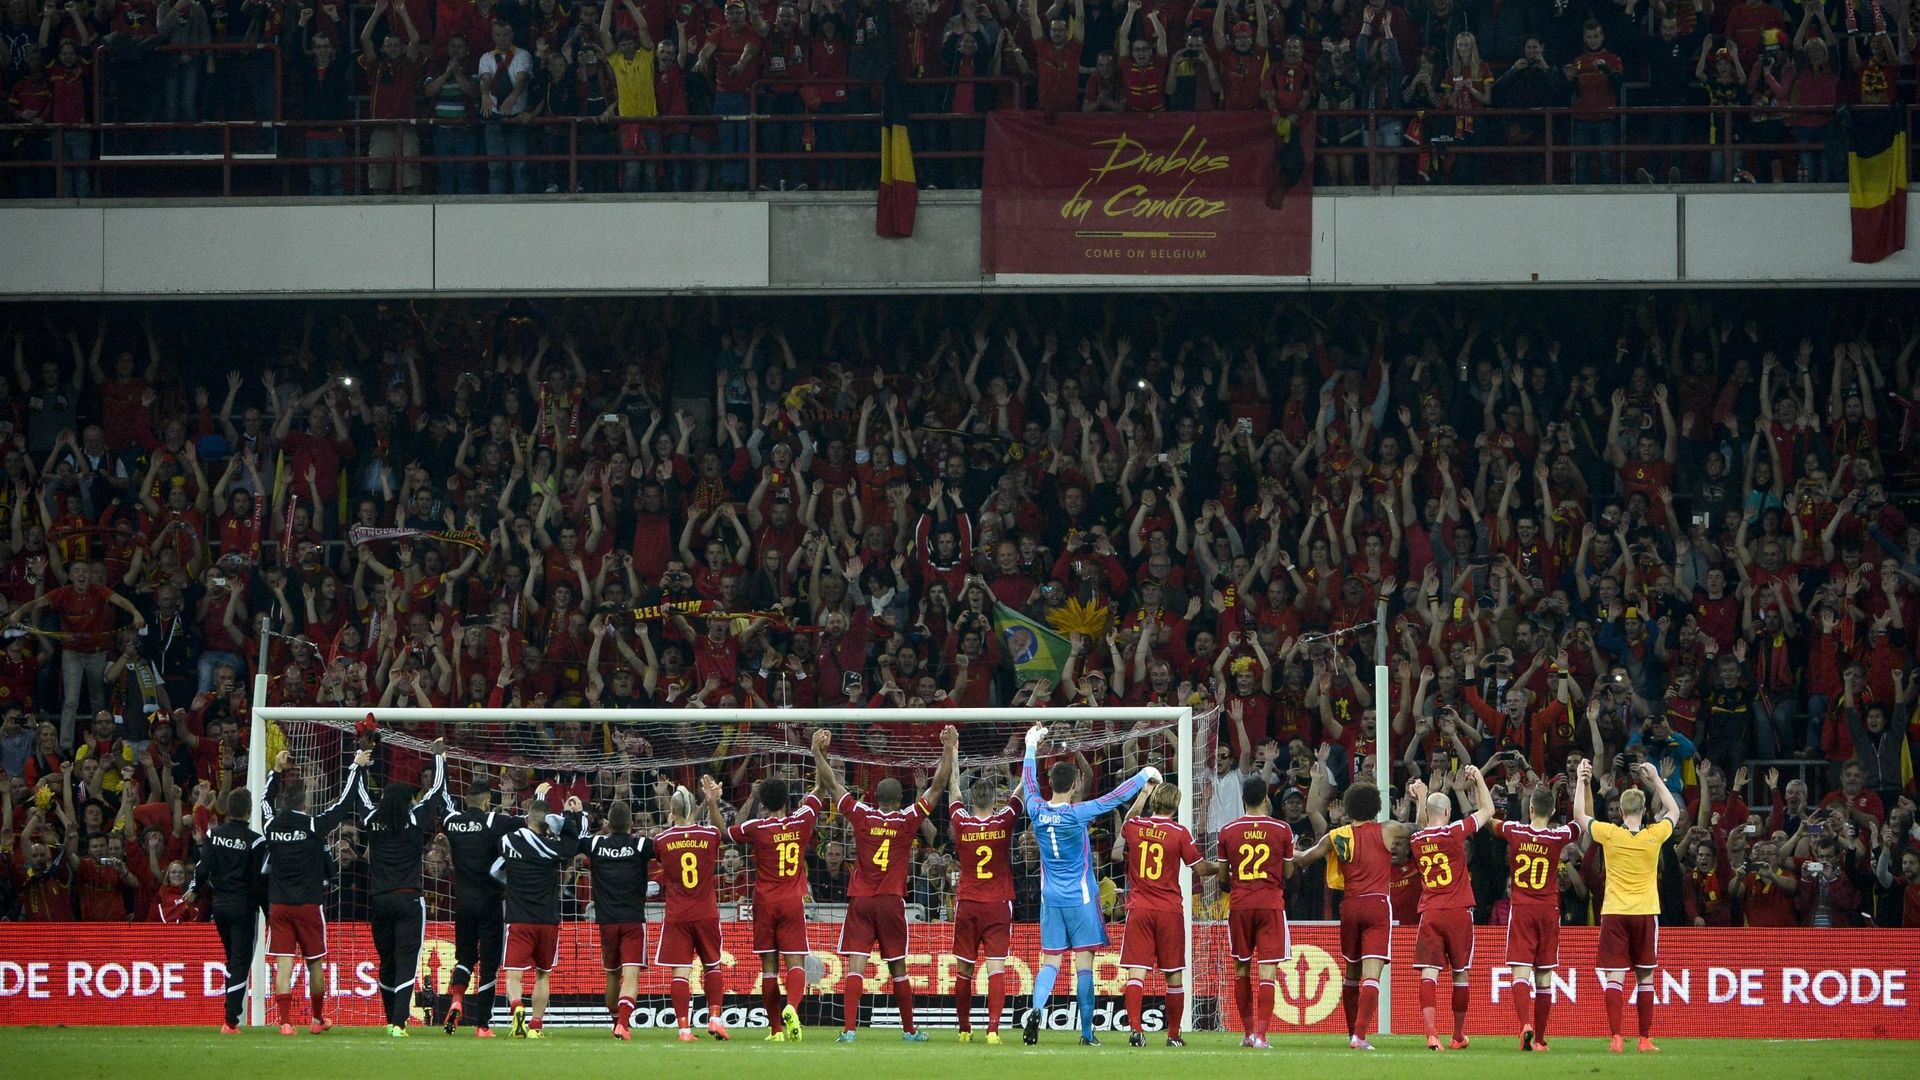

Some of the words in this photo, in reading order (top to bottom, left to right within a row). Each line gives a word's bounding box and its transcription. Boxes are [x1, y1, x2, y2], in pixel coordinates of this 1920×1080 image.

[1090, 125, 1229, 184] Diables
[1061, 178, 1093, 223] du
[1103, 179, 1232, 220] Condroz
[1085, 248, 1121, 259] COME
[1127, 248, 1145, 259] ON
[1150, 248, 1207, 259] BELGIUM
[1636, 468, 1645, 480] 6
[633, 600, 702, 620] BELUM
[212, 836, 233, 848] ING
[270, 831, 291, 841] ING
[448, 822, 467, 832] ING
[1046, 826, 1060, 860] 1
[1244, 831, 1267, 840] CHADLI
[508, 848, 523, 859] IN
[597, 847, 619, 859] ING
[666, 840, 709, 852] NAINGGOLAN
[776, 842, 800, 877] 19
[872, 839, 890, 872] 4
[976, 845, 994, 880] 2
[1138, 841, 1164, 880] 13
[1239, 843, 1270, 880] 22
[1519, 842, 1549, 855] JANUZAJ
[680, 852, 699, 889] 8
[1419, 853, 1452, 888] 23
[1514, 854, 1550, 890] 20
[0, 962, 50, 998] DE
[67, 962, 186, 998] RODE
[1708, 967, 1764, 1006] DE
[1783, 967, 1907, 1007] RODE
